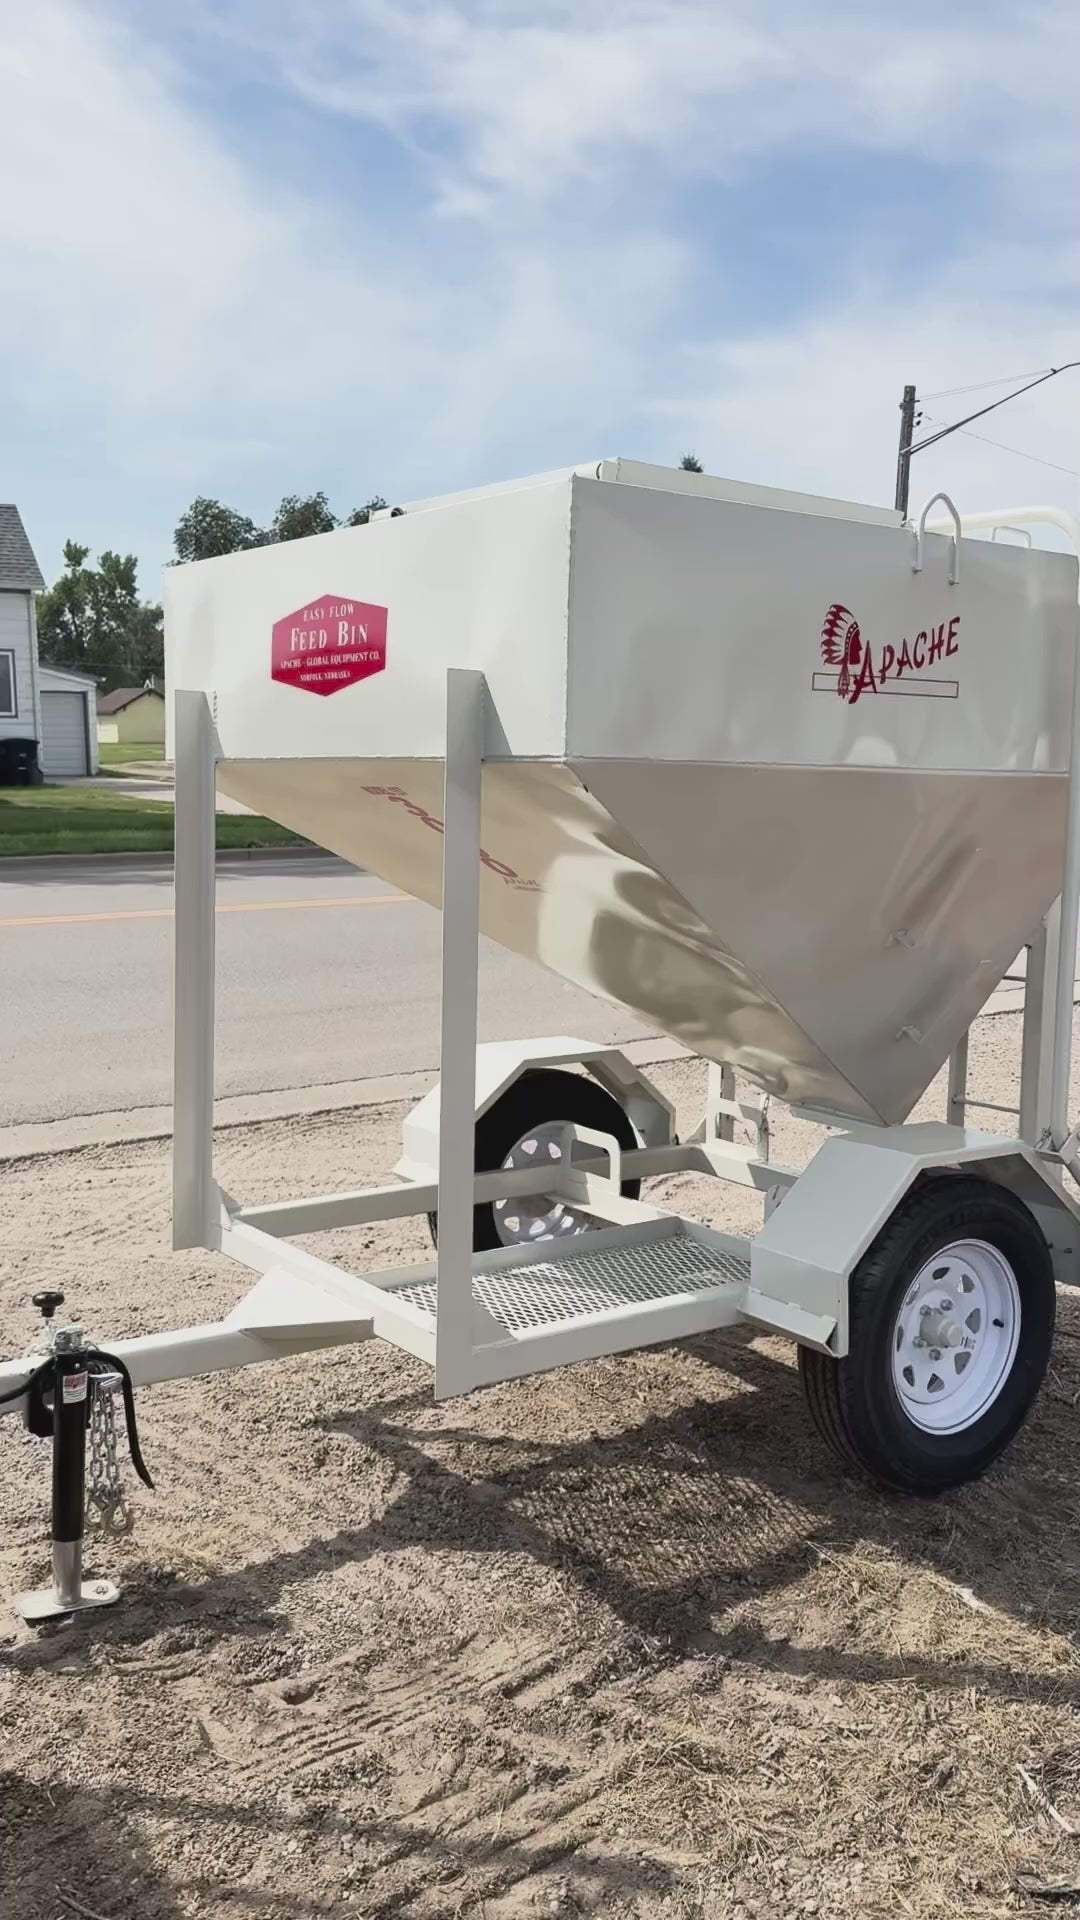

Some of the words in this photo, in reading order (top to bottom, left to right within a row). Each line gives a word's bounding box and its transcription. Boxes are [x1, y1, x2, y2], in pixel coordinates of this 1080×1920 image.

[303, 607, 325, 622] EASY
[329, 603, 354, 618] FLOW
[281, 658, 302, 669] APACHE
[306, 656, 330, 667] GLOBAL
[330, 652, 369, 665] EQUIPMENT
[848, 616, 961, 704] APACHE
[324, 670, 352, 681] NEBRASKA
